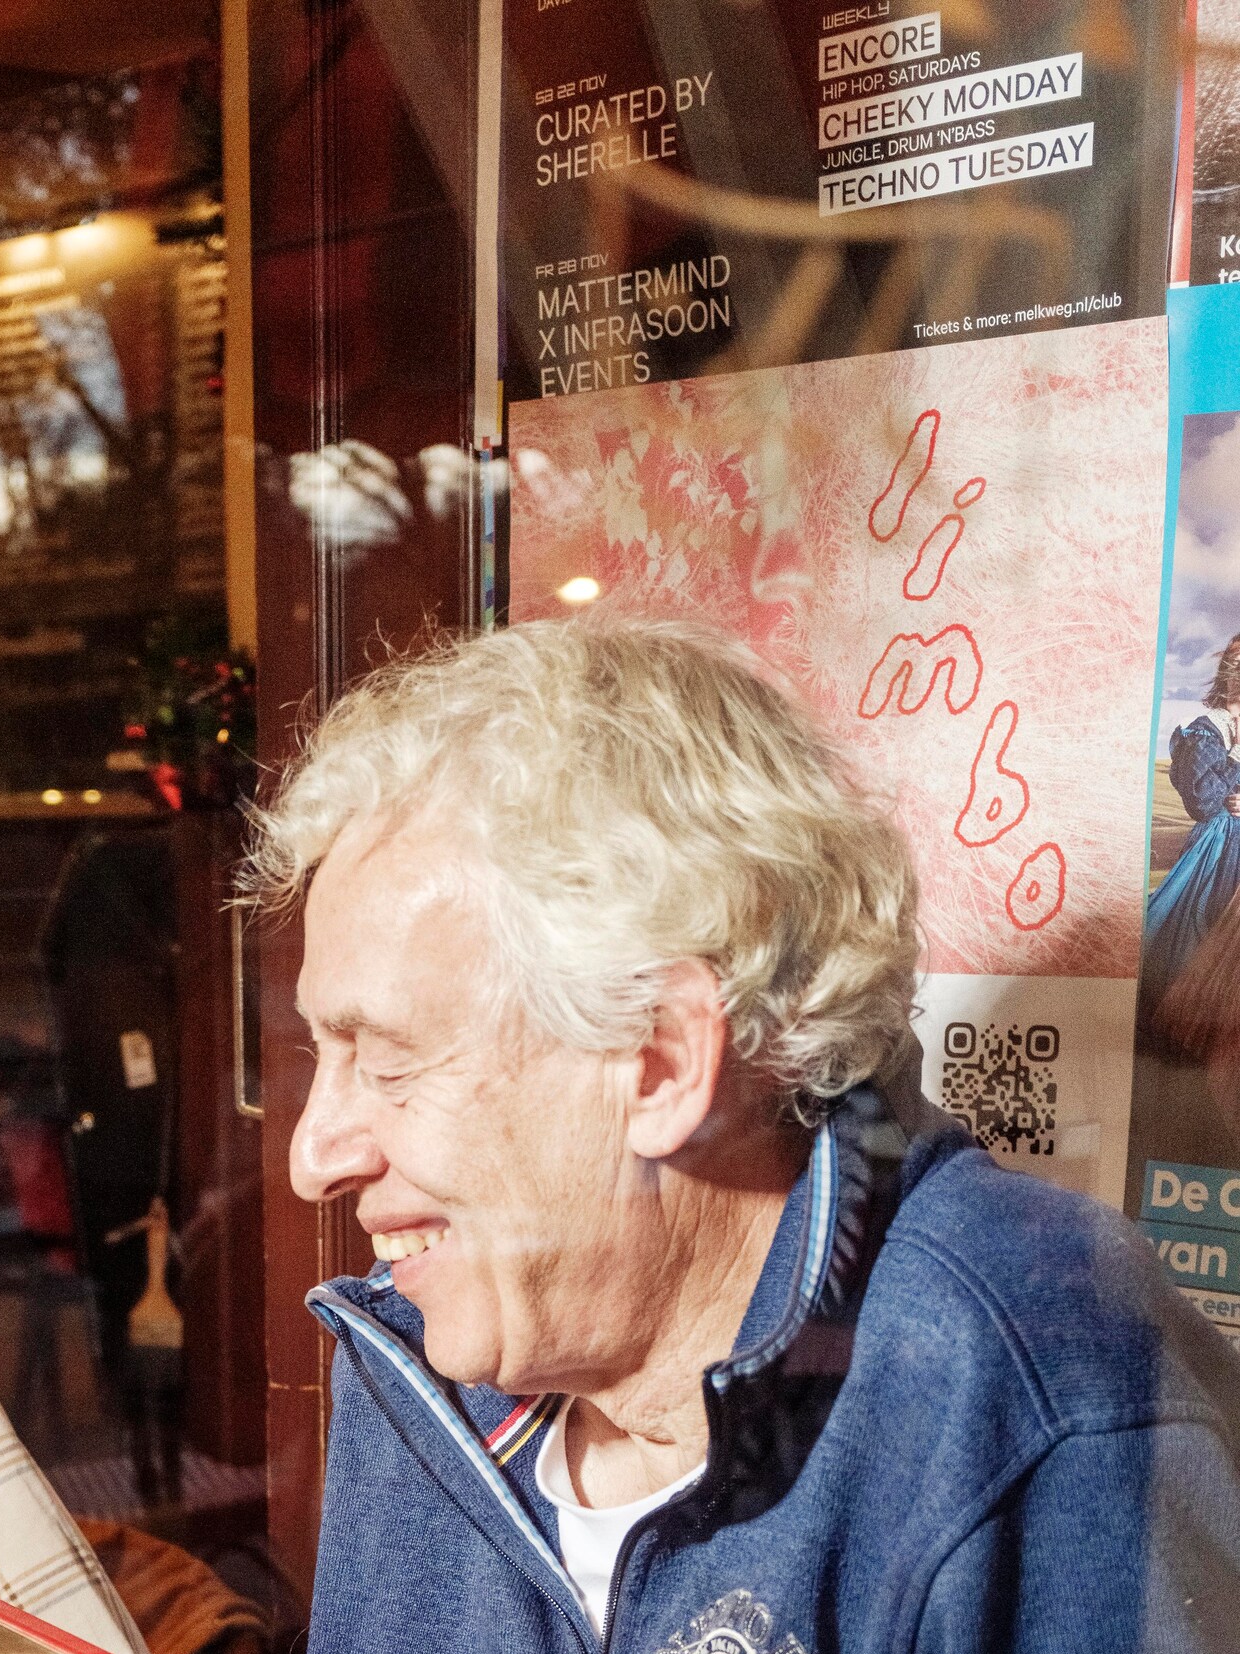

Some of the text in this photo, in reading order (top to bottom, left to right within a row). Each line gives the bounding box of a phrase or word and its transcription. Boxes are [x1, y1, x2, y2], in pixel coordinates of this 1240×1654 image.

[823, 21, 936, 74] ENCORE
[557, 82, 576, 99] 22
[823, 51, 981, 101] HIP HOP, SATURDAYS
[536, 71, 713, 146] CURATED BY
[823, 62, 1077, 141] CHEEKY MONDAY
[536, 123, 677, 187] SHERELLE
[823, 143, 884, 170] JUNGLE,
[888, 132, 933, 156] DRUM
[823, 131, 1089, 210] TECHNO TUESDAY
[558, 258, 576, 275] 28
[1220, 234, 1240, 258] K
[538, 254, 730, 320] MATTERMIND
[538, 295, 730, 360] X INFRASOON
[913, 291, 1122, 338] Tickets & more: melkweg.nl/club
[540, 351, 650, 399] EVENTS
[1151, 1169, 1209, 1213] De
